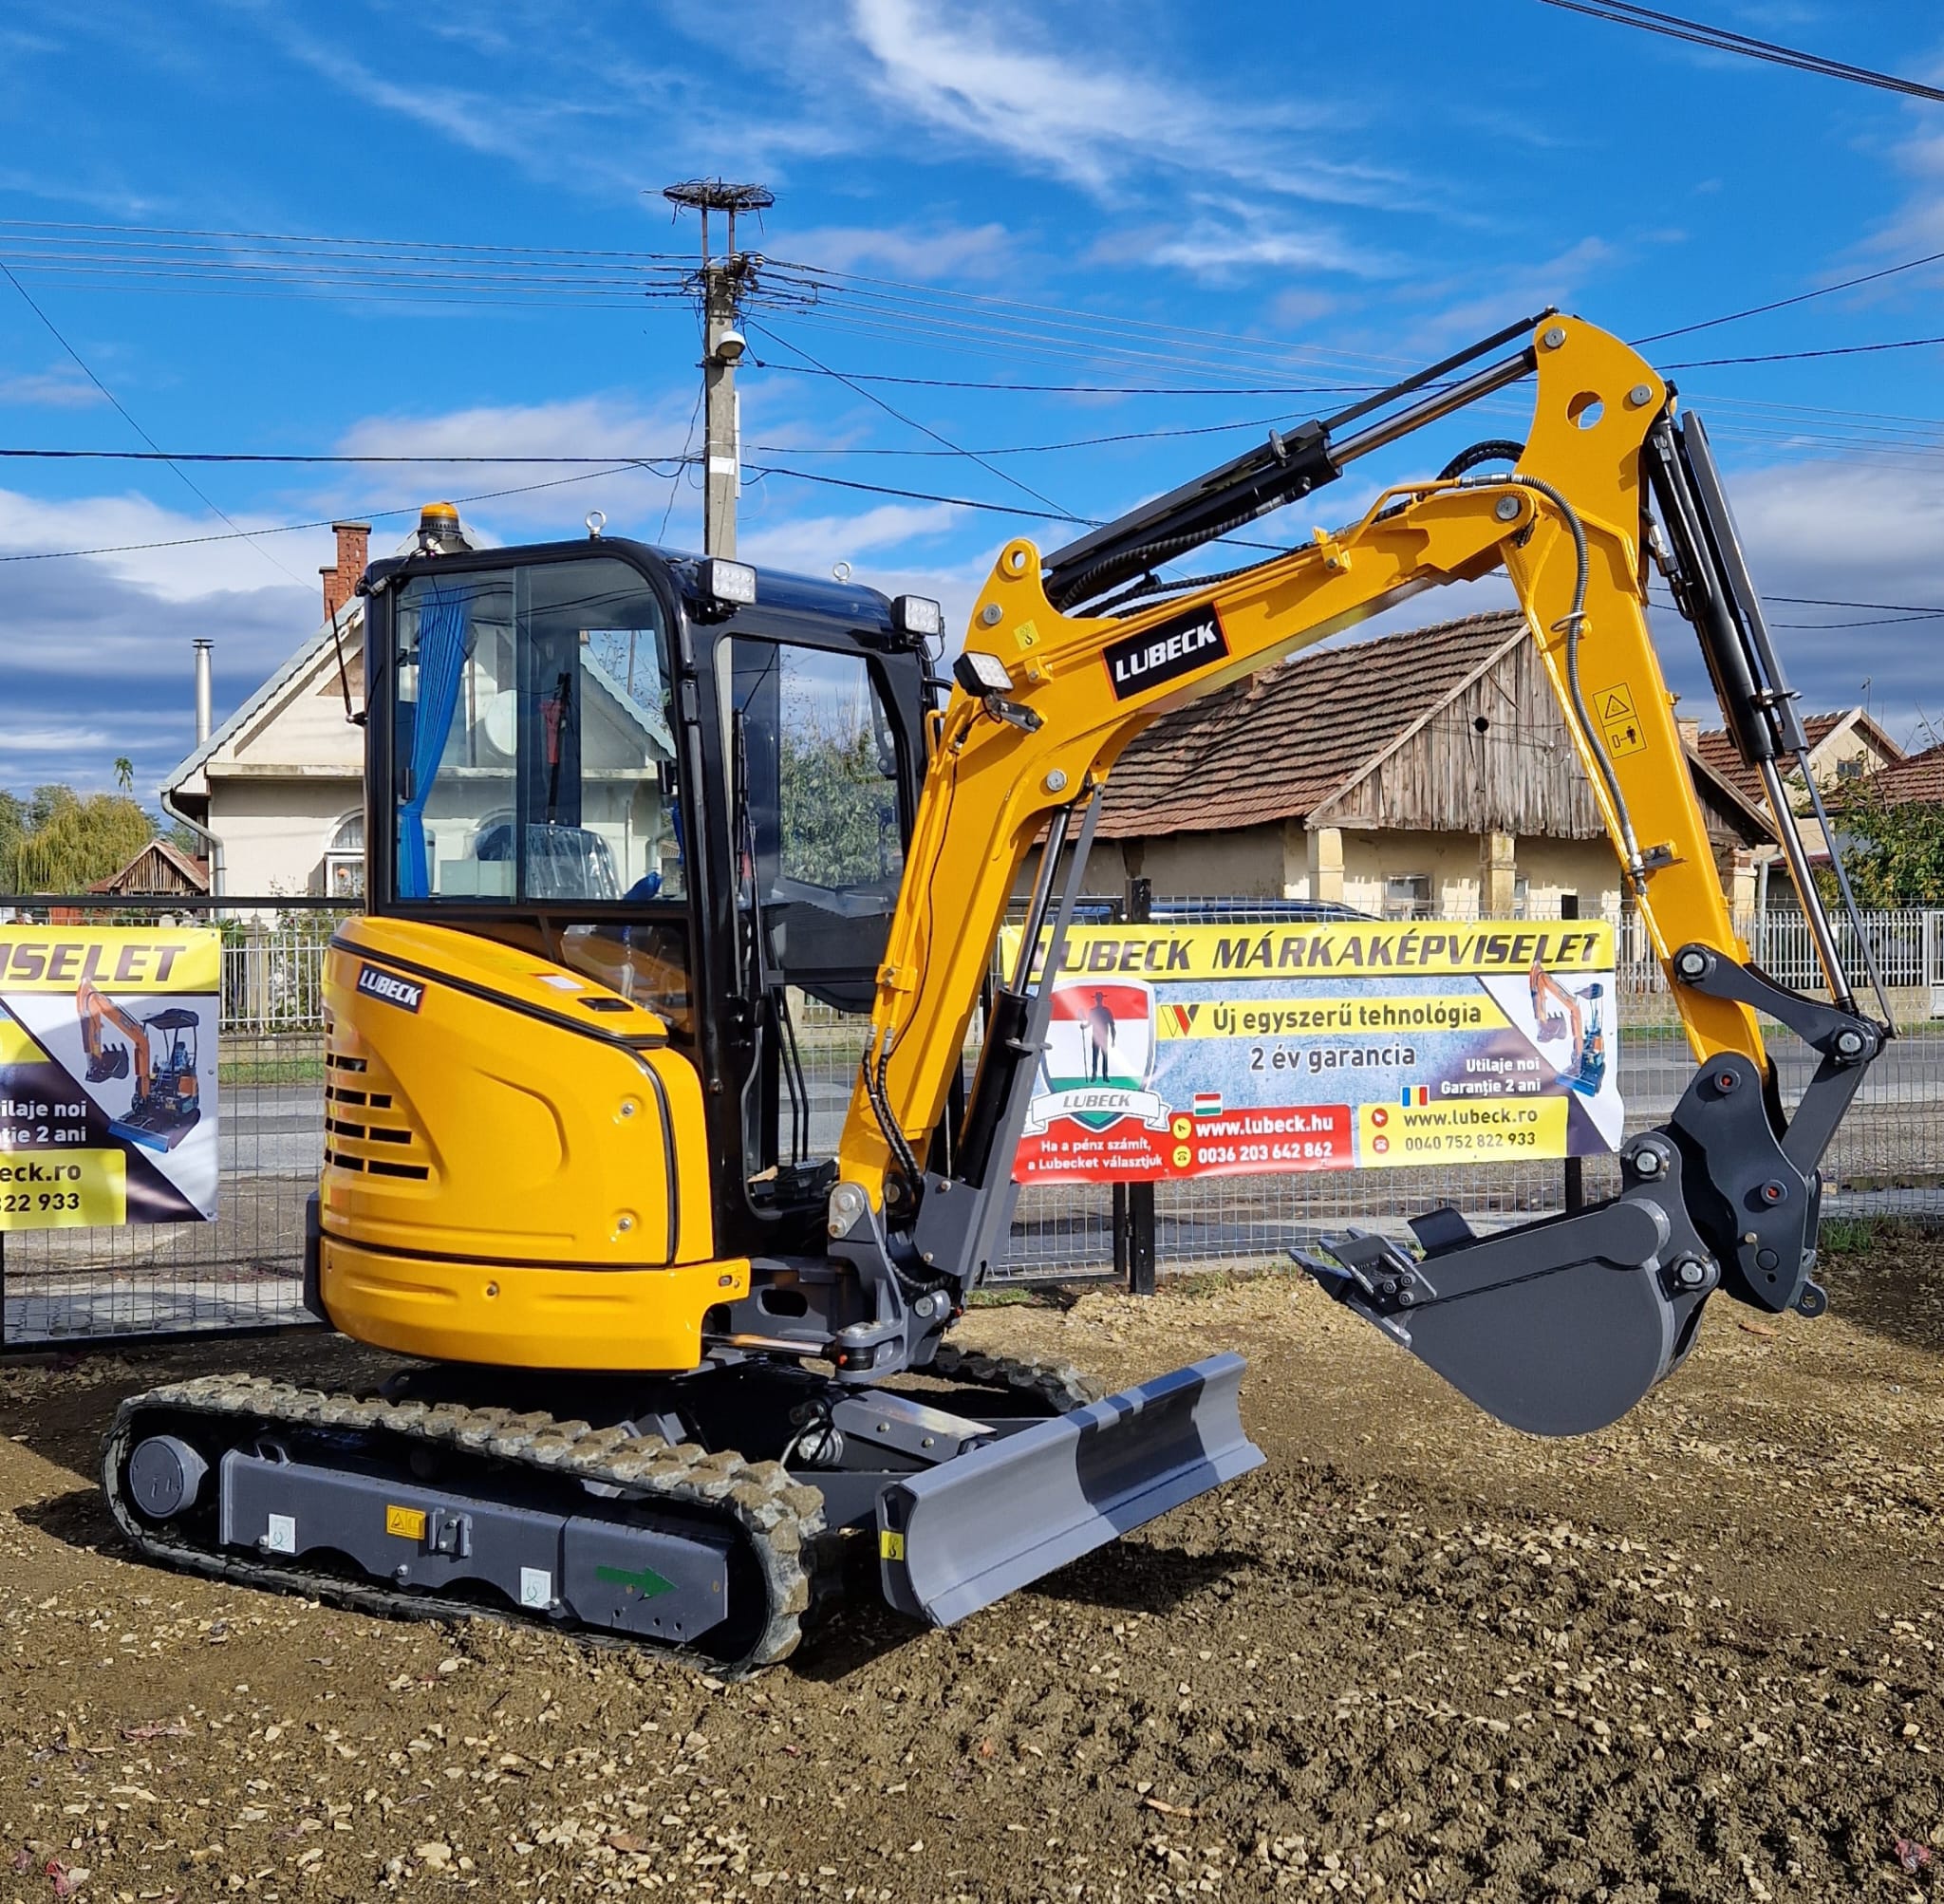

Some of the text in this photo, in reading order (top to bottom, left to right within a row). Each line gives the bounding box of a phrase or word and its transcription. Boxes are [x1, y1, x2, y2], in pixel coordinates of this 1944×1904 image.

[1115, 621, 1217, 682] LUBECK
[1212, 928, 1600, 969] MÁRKAKÉPVISELET
[359, 969, 422, 1006] LUBECK
[1213, 1001, 1482, 1036] Új egyszerű tehnológia
[1250, 1044, 1416, 1074] 2 év garancia
[1466, 1056, 1540, 1074] Utilaje noi
[1505, 1078, 1514, 1092] 2
[1518, 1078, 1541, 1092] ani
[54, 1101, 86, 1117] noi
[1063, 1093, 1131, 1109] LUBECK
[1195, 1115, 1334, 1137] www.lubeck.hu
[1404, 1108, 1538, 1127] www.lubeck.ro
[36, 1126, 49, 1143] 2
[54, 1127, 86, 1142] ani
[1405, 1131, 1536, 1151] 0040 752 822 933
[1040, 1141, 1057, 1152] Ha
[1061, 1143, 1069, 1151] a
[1073, 1138, 1104, 1153] pénz
[1198, 1142, 1333, 1164] 0036 203 642 862
[1028, 1154, 1163, 1170] a Lubecket választjuk
[0, 1192, 80, 1213] 22 933
